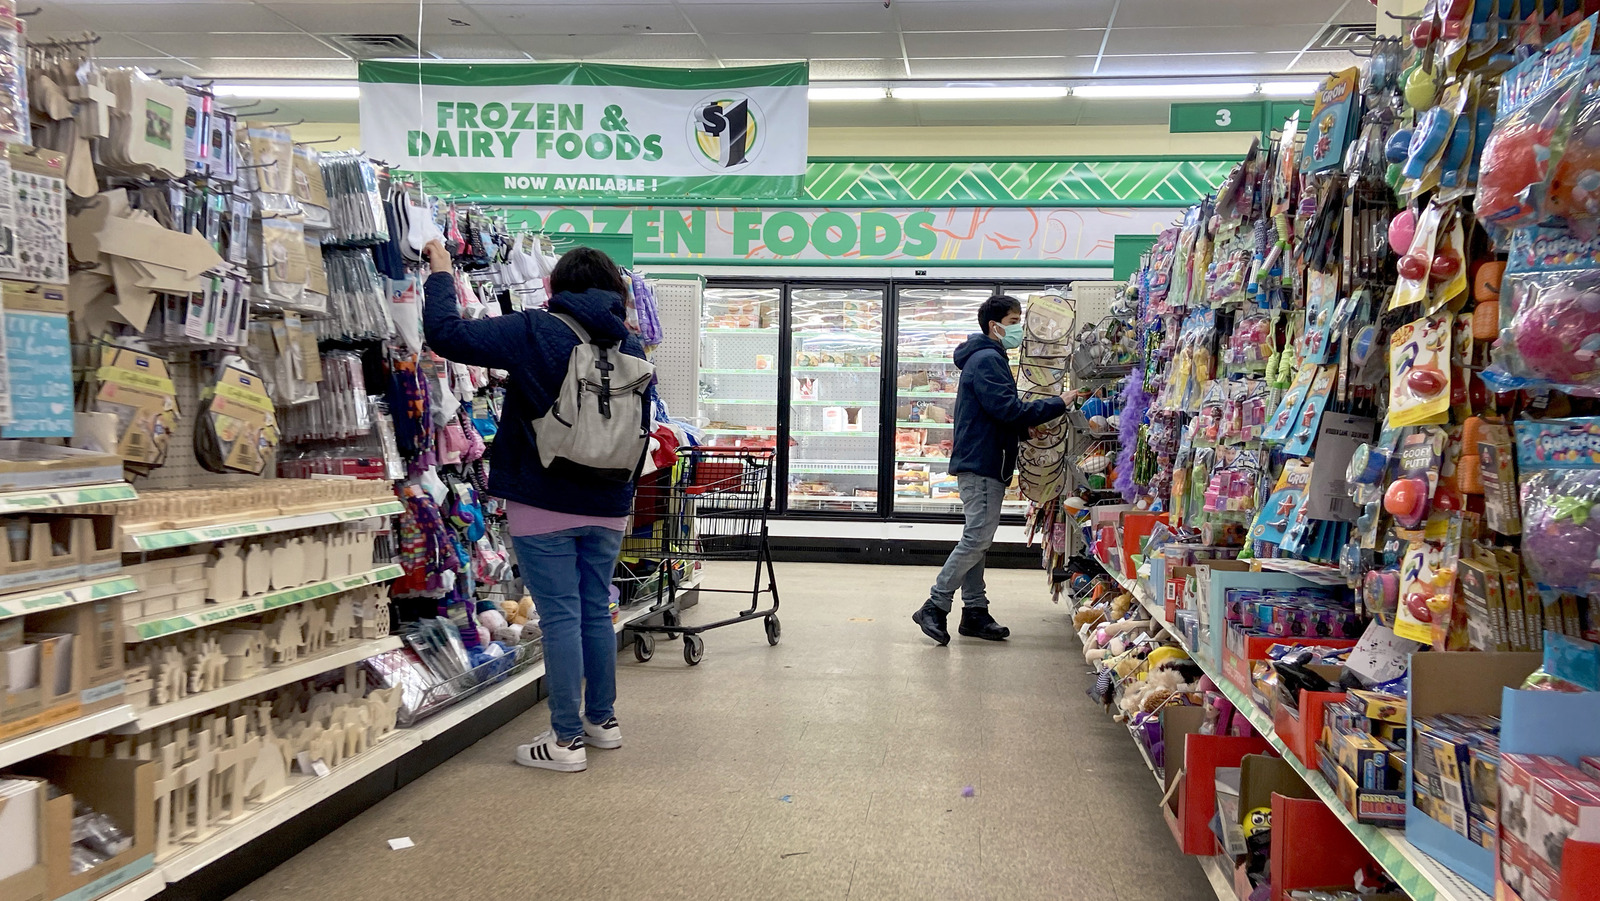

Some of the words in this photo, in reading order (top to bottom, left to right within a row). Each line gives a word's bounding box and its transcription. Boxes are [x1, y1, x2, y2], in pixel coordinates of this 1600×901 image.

[1322, 83, 1347, 103] GROW
[437, 101, 584, 131] FROZEN
[599, 104, 631, 132] &
[1215, 108, 1232, 127] 3
[407, 130, 521, 159] DAIRY
[536, 132, 664, 162] FOODS
[503, 176, 548, 190] NOW
[553, 177, 645, 192] AVAILABLE
[500, 208, 706, 255] ROZEN
[733, 210, 938, 257] FOODS
[1402, 446, 1432, 459] GOOEY
[1404, 458, 1431, 469] PUTTY
[1361, 801, 1406, 816] BLOCKS
